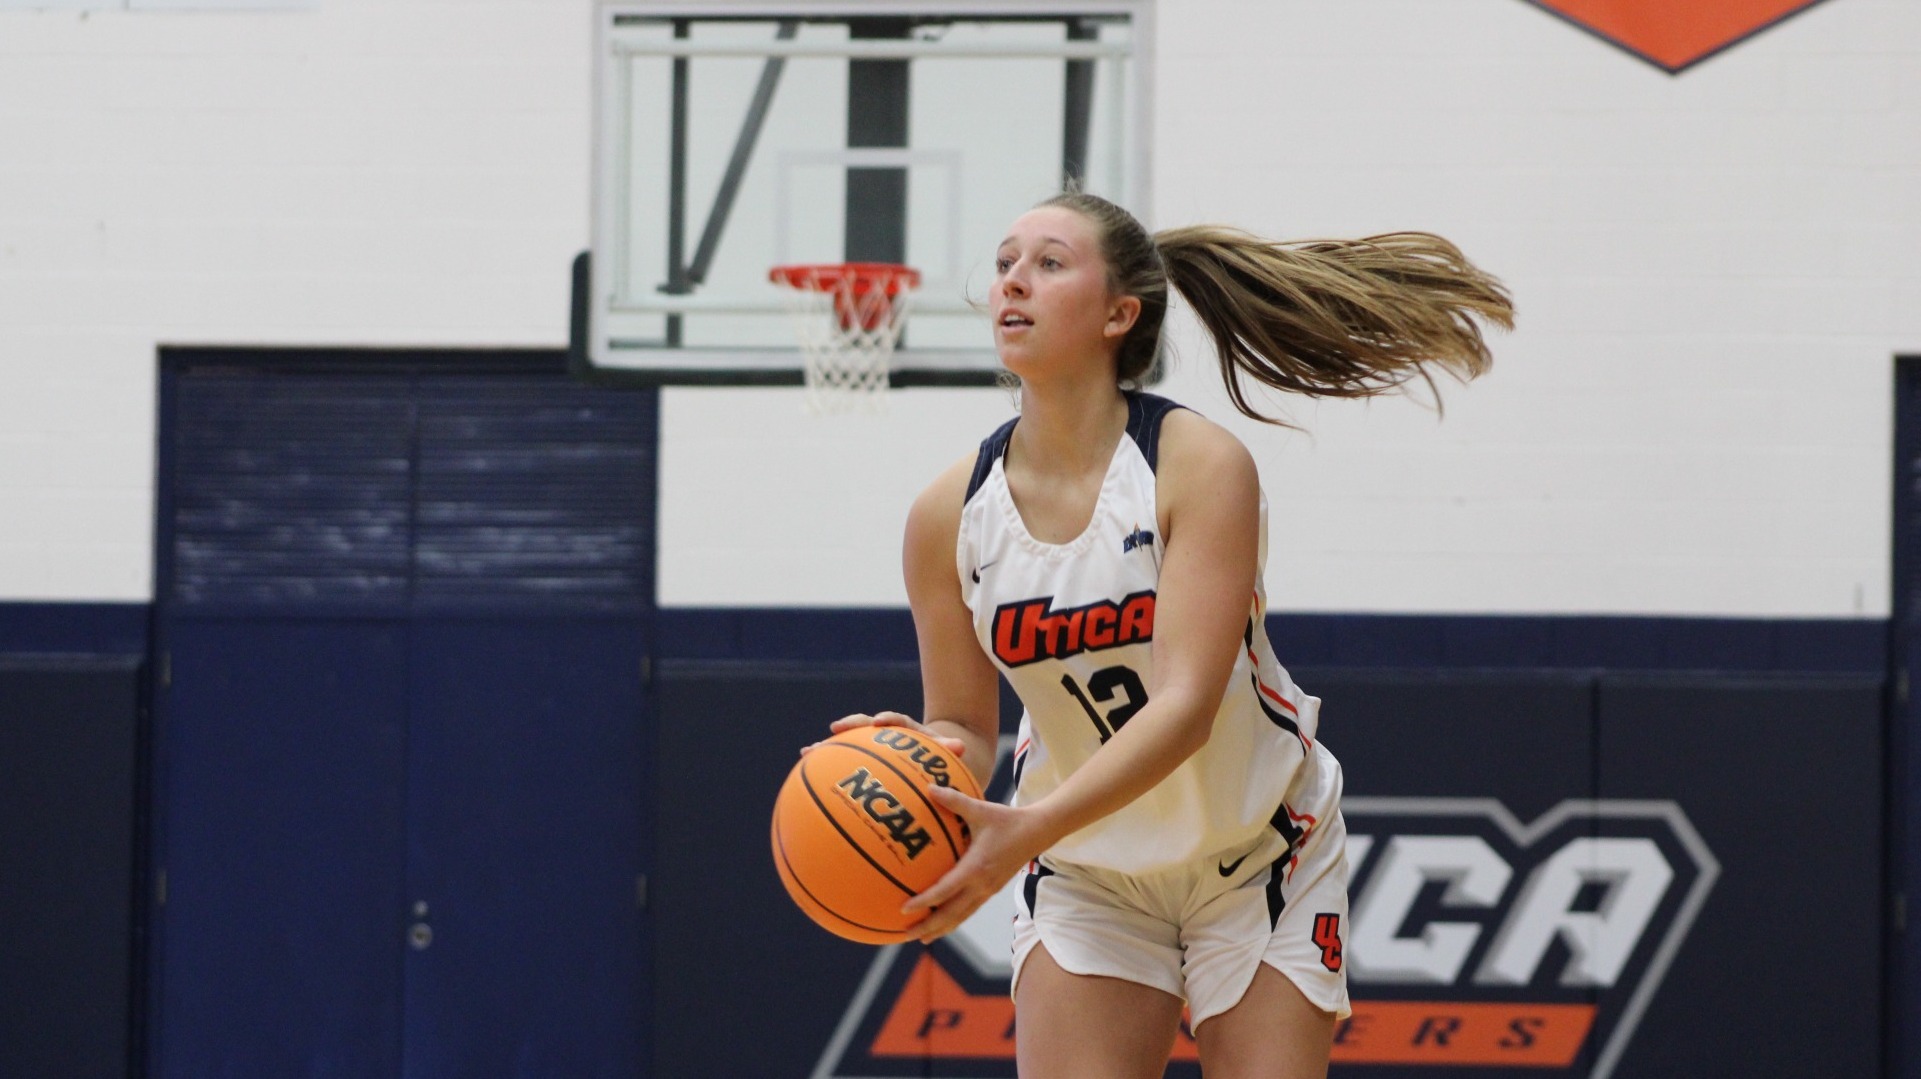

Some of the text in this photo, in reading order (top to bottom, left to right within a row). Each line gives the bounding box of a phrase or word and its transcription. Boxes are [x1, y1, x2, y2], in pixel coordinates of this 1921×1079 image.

[992, 589, 1156, 668] UTICA
[1061, 665, 1149, 745] 12
[872, 728, 960, 800] Wils
[836, 766, 932, 861] NCAA
[915, 1009, 1547, 1048] PERS
